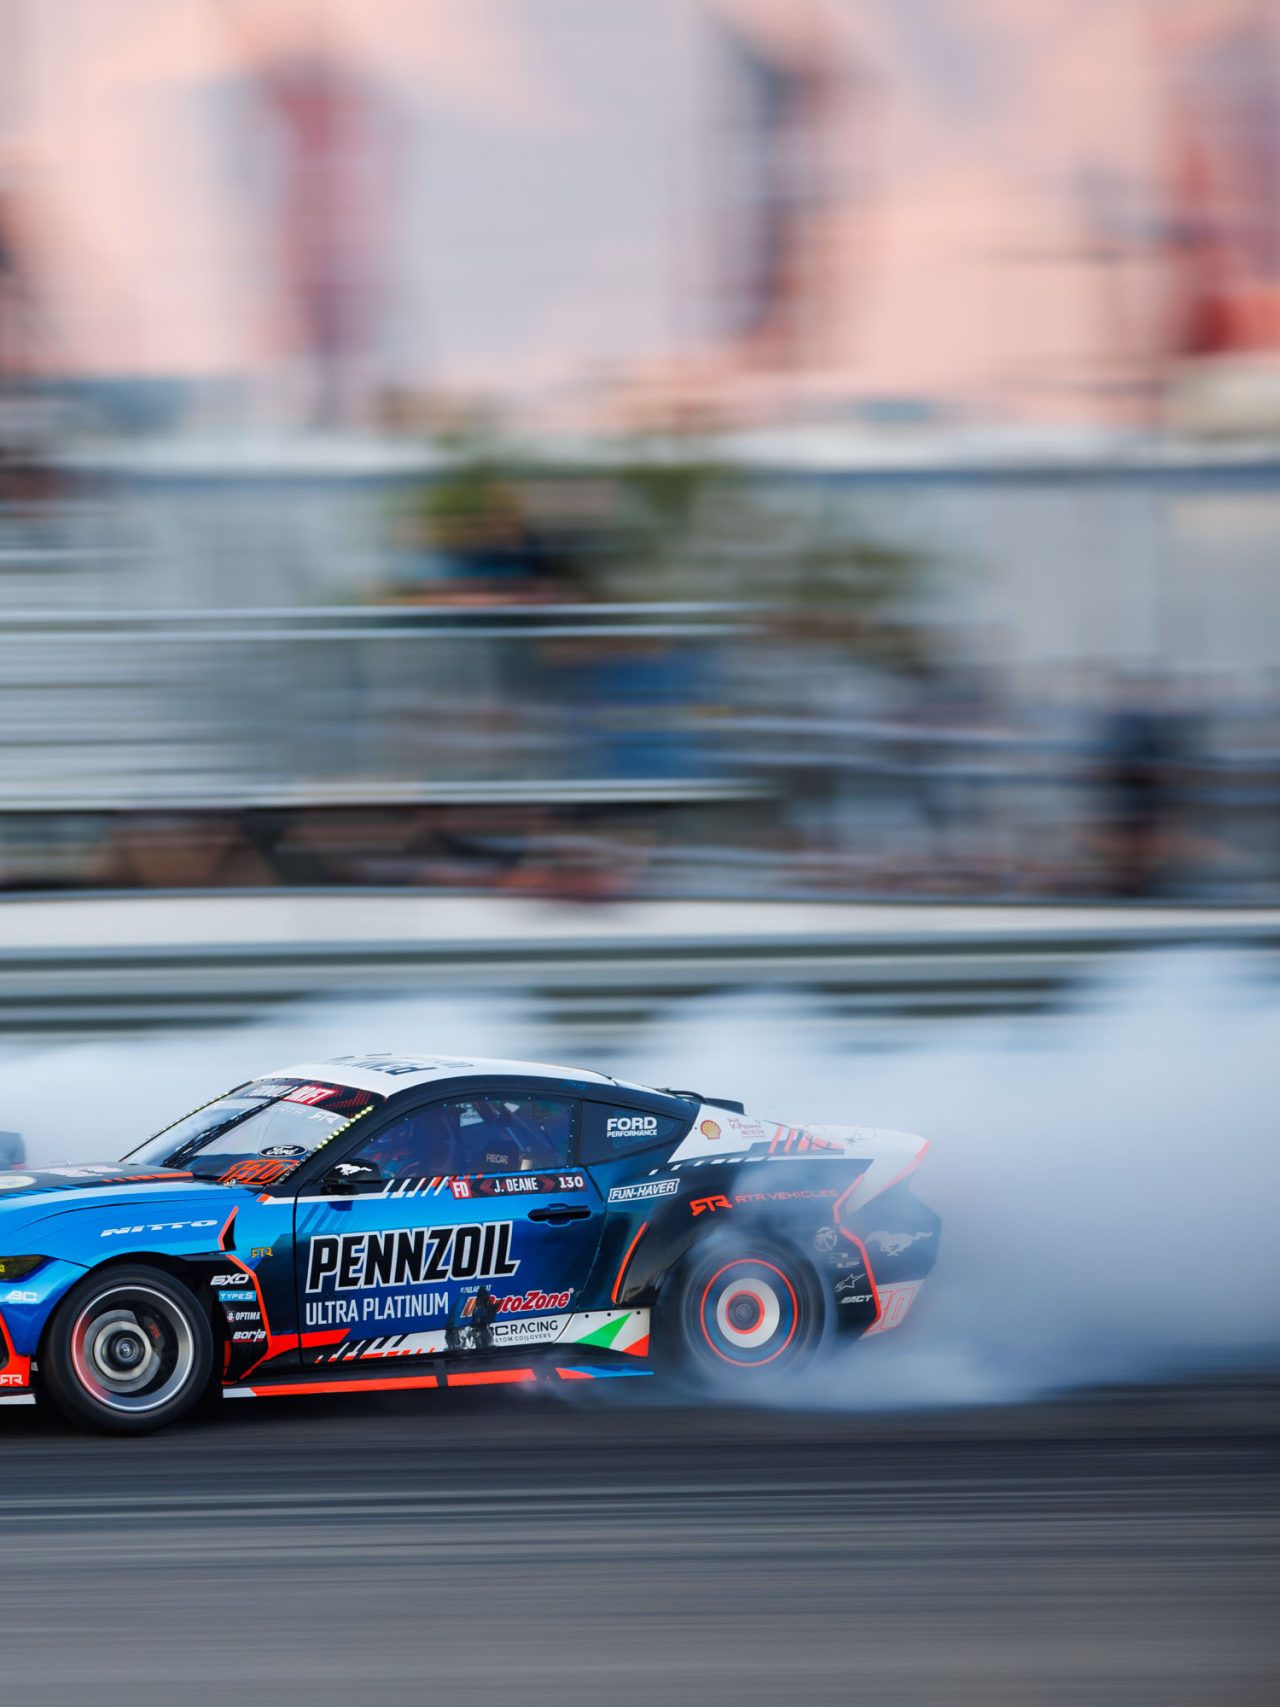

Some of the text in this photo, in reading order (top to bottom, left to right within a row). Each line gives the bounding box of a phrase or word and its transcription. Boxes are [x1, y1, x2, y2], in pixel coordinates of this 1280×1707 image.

[606, 1128, 658, 1138] PERFORMANCE
[607, 1116, 658, 1131] FORD
[452, 1175, 584, 1198] FD J. DEANE 130
[611, 1181, 677, 1200] FUN-HAVER
[734, 1192, 765, 1204] RTR
[769, 1188, 841, 1201] VEHICLES
[100, 1219, 218, 1238] NITTO
[305, 1220, 521, 1294] PENNZOIL
[305, 1291, 449, 1326] ULTRA PLATINUM
[488, 1290, 572, 1314] utoZone
[235, 1311, 261, 1321] OPTIMA
